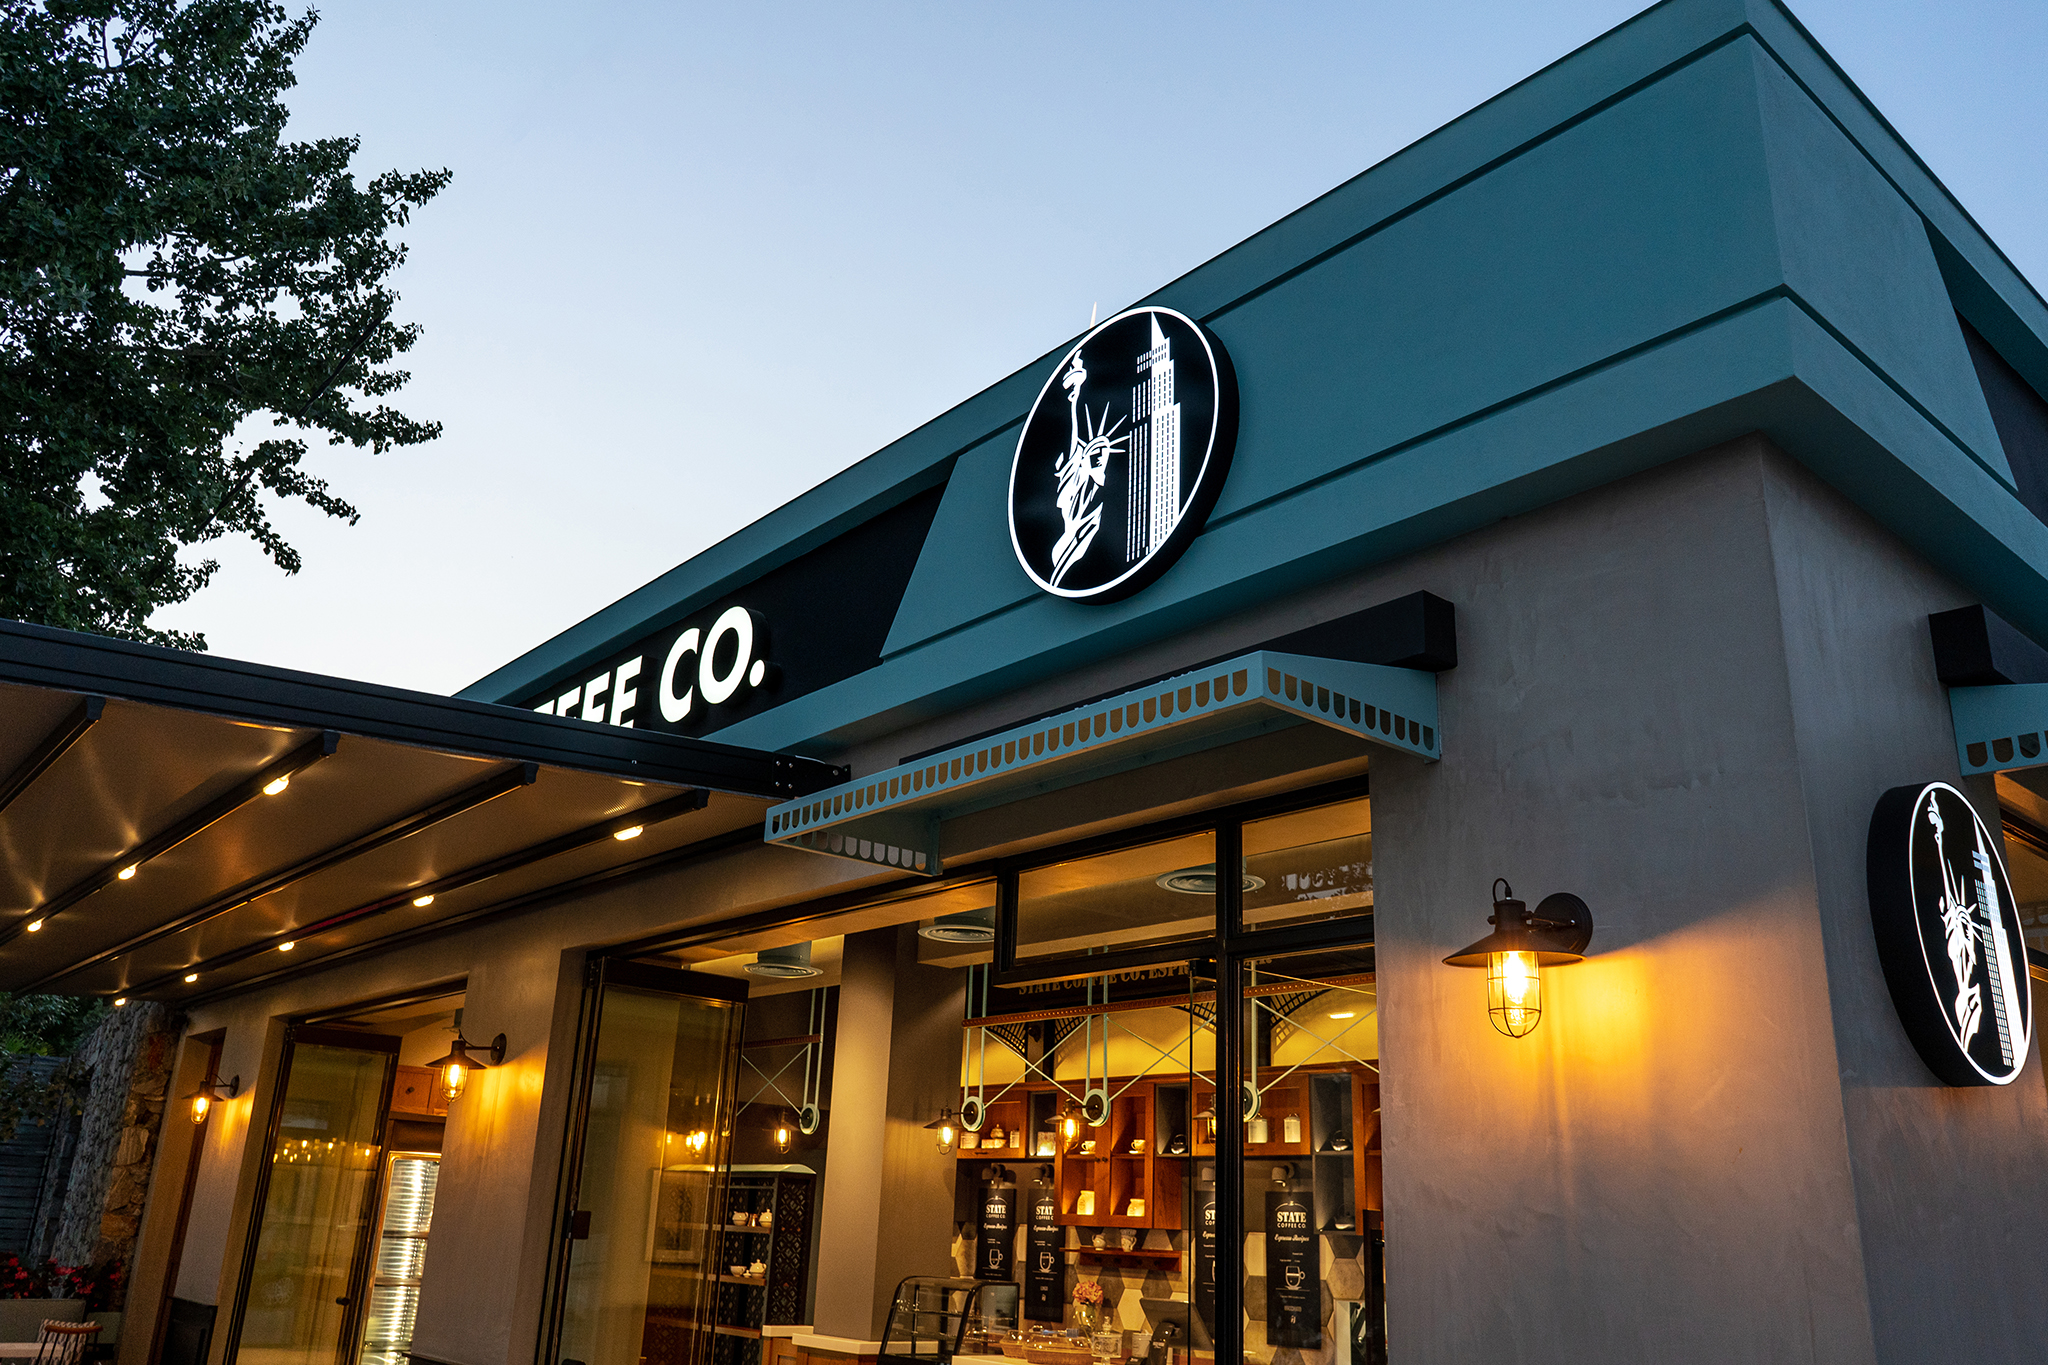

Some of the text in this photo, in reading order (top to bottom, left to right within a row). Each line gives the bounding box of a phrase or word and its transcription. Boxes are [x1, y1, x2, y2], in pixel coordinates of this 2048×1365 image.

[659, 605, 765, 723] CO.
[986, 1205, 1006, 1213] STATE
[1036, 1206, 1054, 1215] STAT
[1277, 1211, 1306, 1222] STATE
